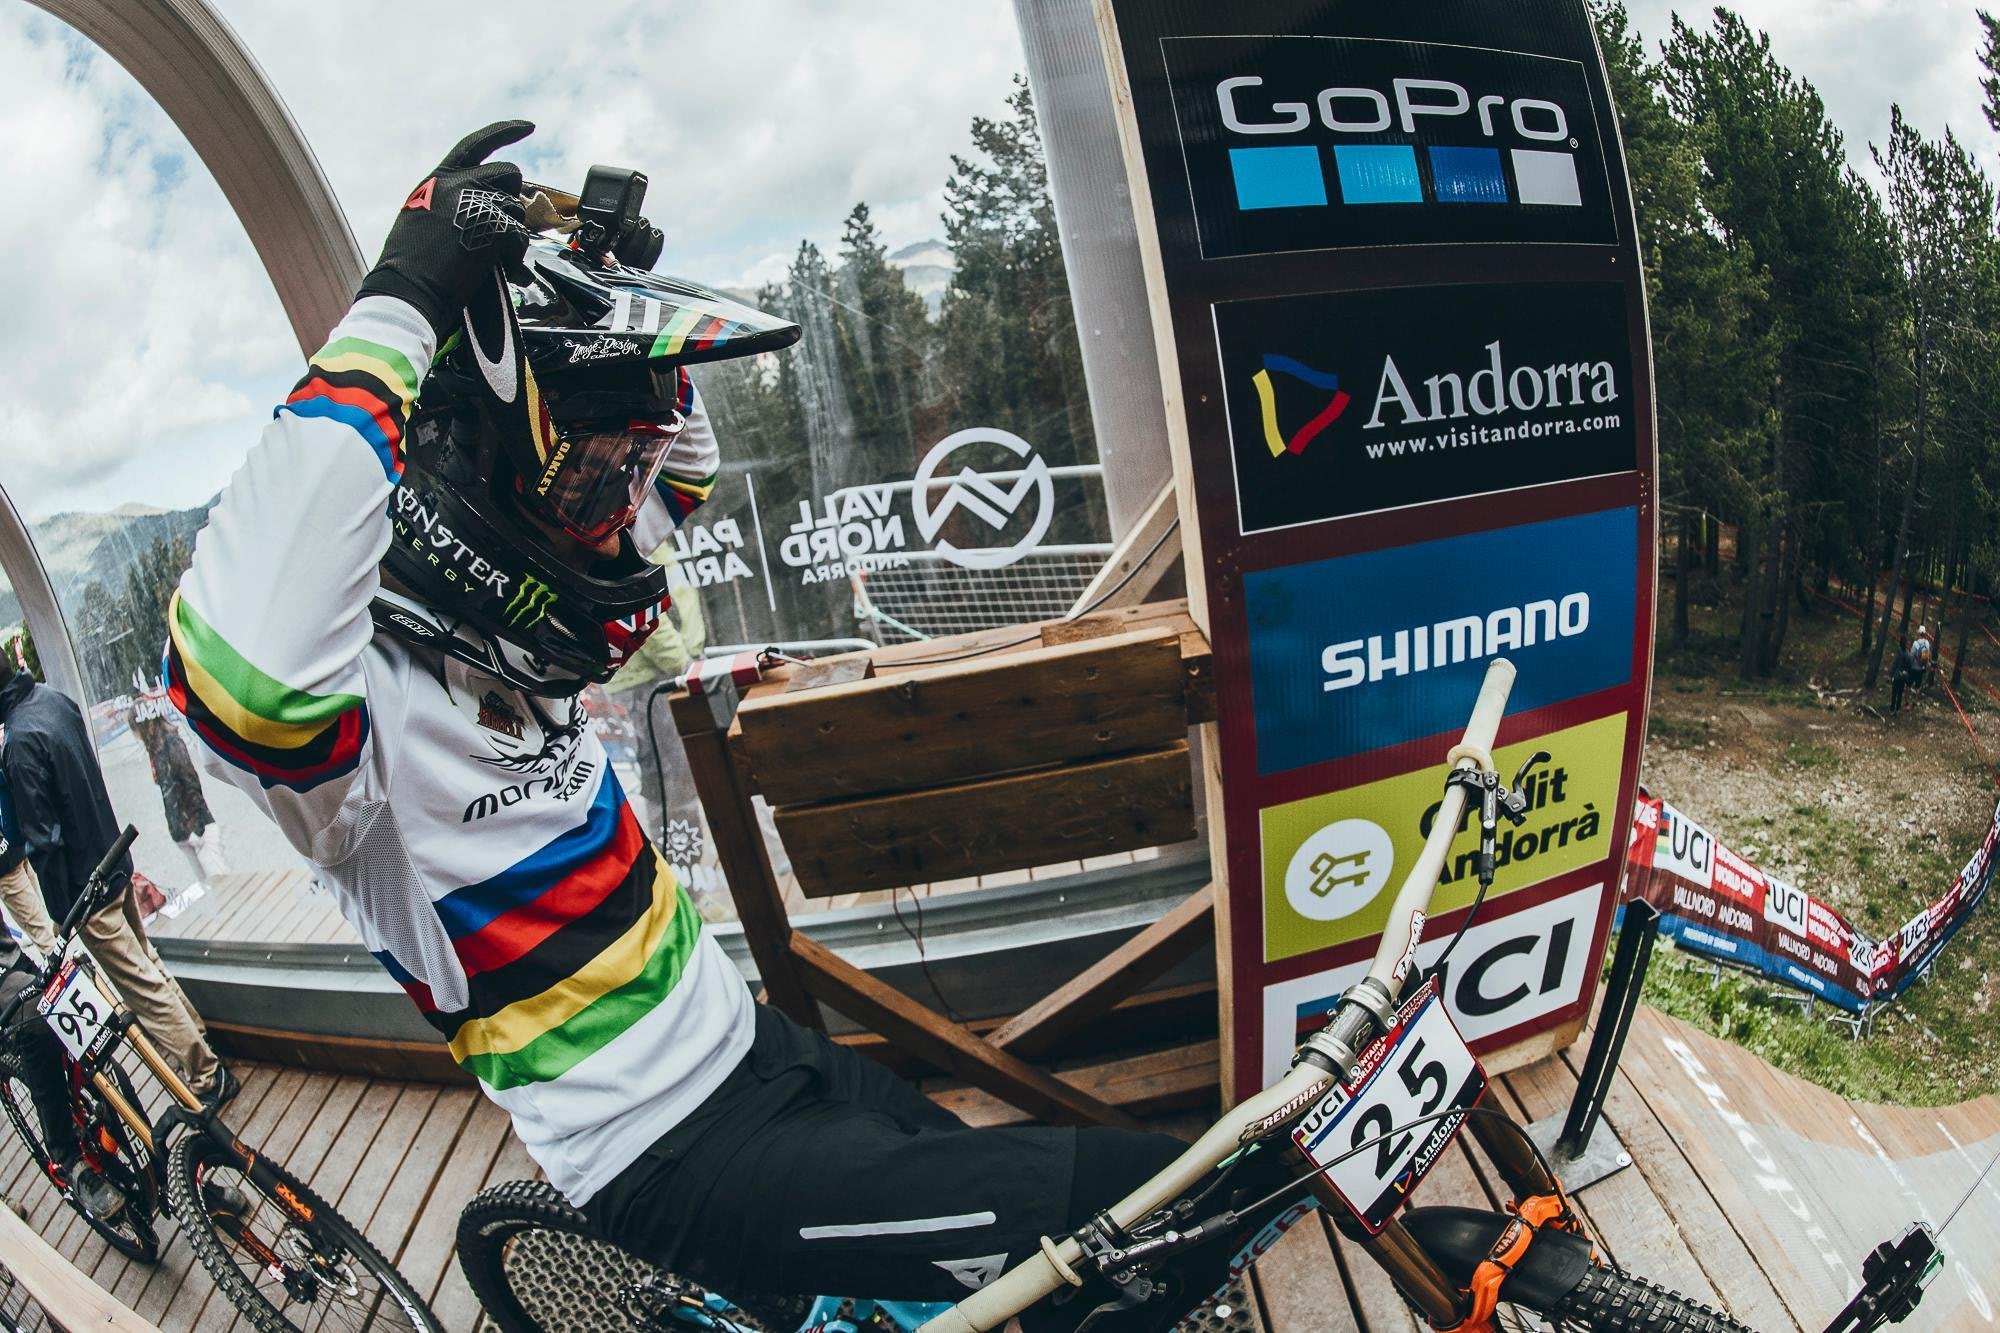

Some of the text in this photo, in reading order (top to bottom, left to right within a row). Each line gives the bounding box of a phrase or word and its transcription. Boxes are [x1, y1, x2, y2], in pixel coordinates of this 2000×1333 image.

[1216, 75, 1568, 141] GoPro
[599, 335, 641, 356] Design
[1362, 340, 1619, 429] Andorra
[1366, 414, 1620, 459] www.visitandorra.com
[537, 441, 572, 497] OAKLEY
[395, 520, 475, 593] NERGY
[396, 485, 511, 599] ONSTER
[1321, 591, 1590, 691] SHIMANO
[1672, 816, 1711, 874] UCI
[1773, 883, 1804, 926] UCI
[1902, 914, 1929, 950] UCI
[58, 988, 98, 1047] 95
[1398, 981, 1433, 1018] VALLNORD
[1402, 989, 1432, 1026] ANDORRA
[1347, 1062, 1375, 1093] WORLD
[1372, 1044, 1387, 1063] CUP
[1360, 1039, 1383, 1067] NTAIN
[1263, 1080, 1327, 1130] RENTHAL
[1303, 1089, 1345, 1134] UCI
[1350, 1036, 1448, 1180] 25
